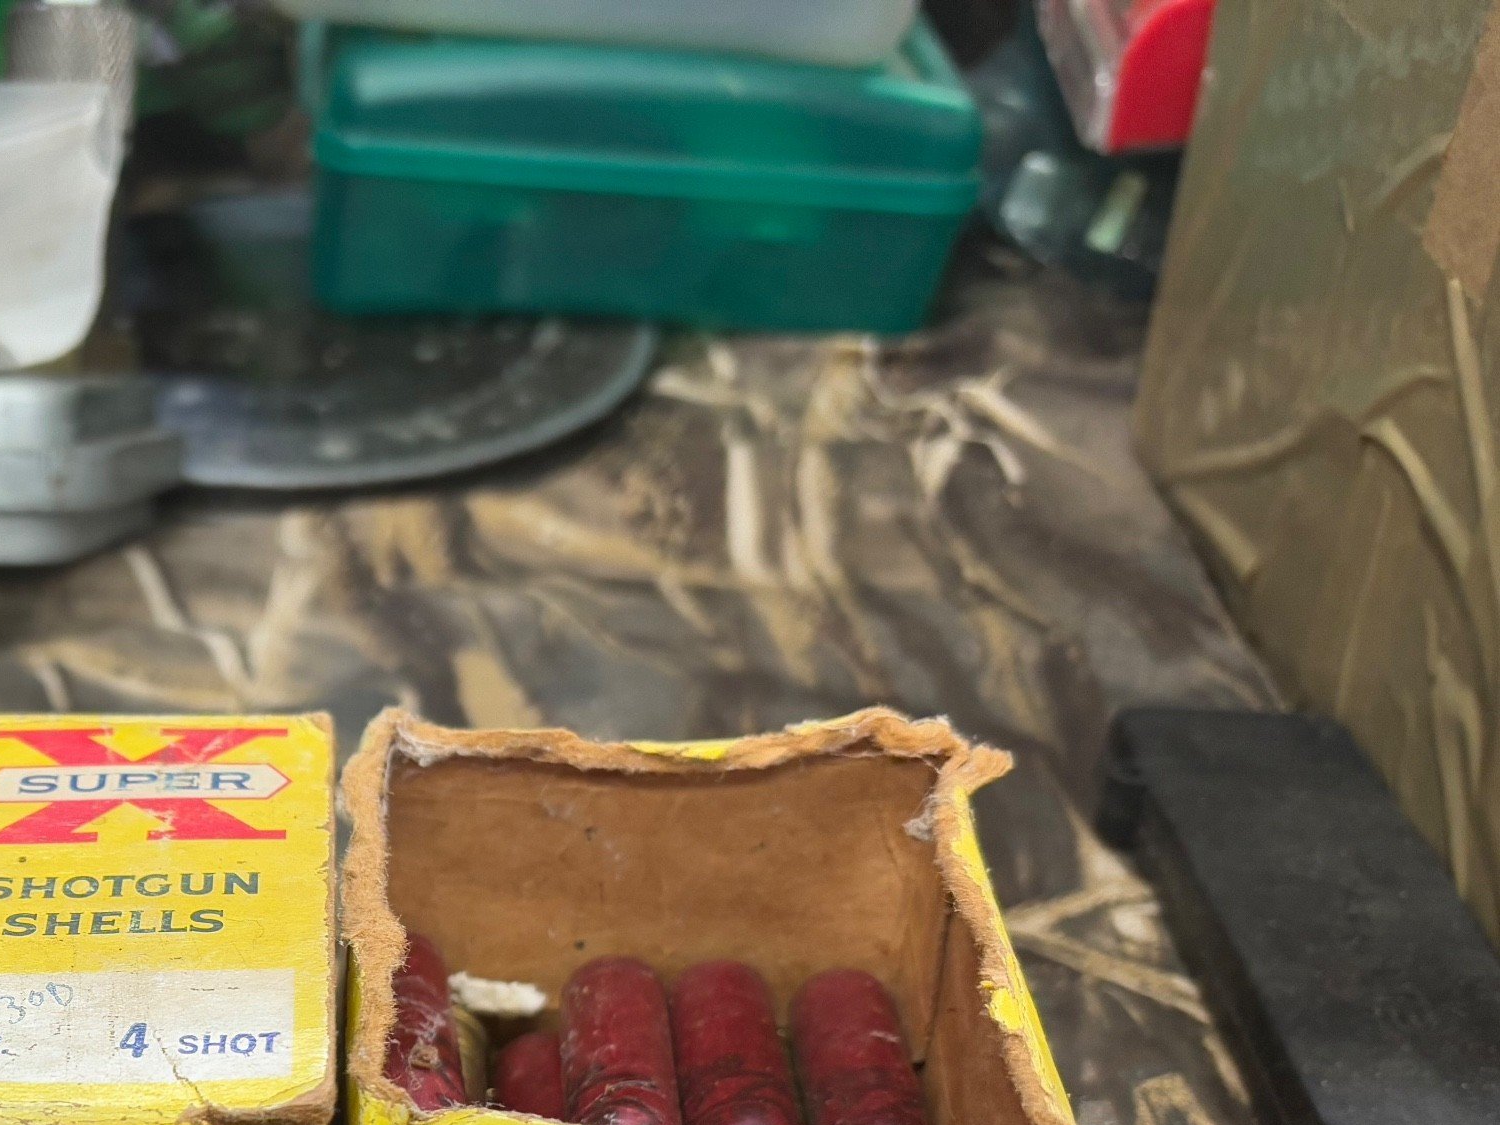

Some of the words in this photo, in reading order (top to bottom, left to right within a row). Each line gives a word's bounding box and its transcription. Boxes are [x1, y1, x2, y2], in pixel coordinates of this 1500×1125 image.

[18, 772, 254, 795] SUPER
[1, 908, 225, 937] SHELLS
[119, 1022, 150, 1058] 4
[177, 1031, 282, 1056] SHOT
